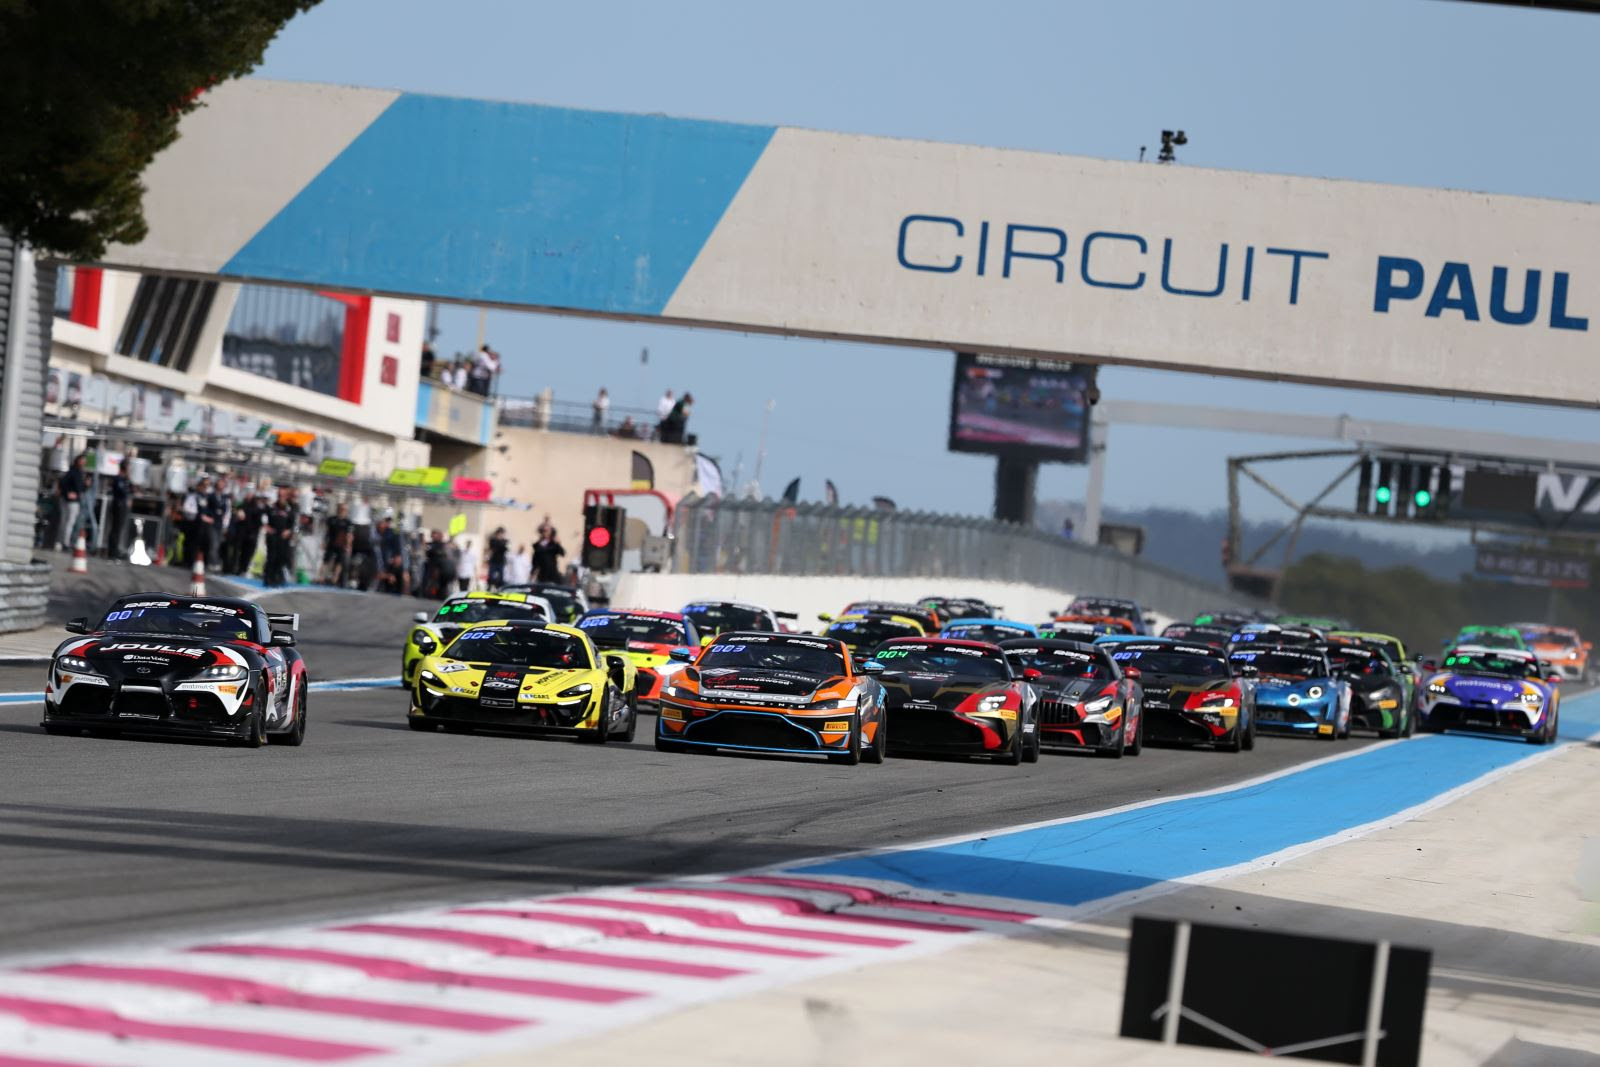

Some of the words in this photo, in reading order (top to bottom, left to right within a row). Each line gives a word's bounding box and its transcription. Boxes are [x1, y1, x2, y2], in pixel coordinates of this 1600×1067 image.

[897, 214, 1330, 305] CIRCUIT
[1373, 255, 1589, 332] PAUL
[460, 632, 495, 640] 002
[100, 643, 206, 656] JOULIE
[711, 645, 746, 653] 003
[876, 650, 908, 659] 004
